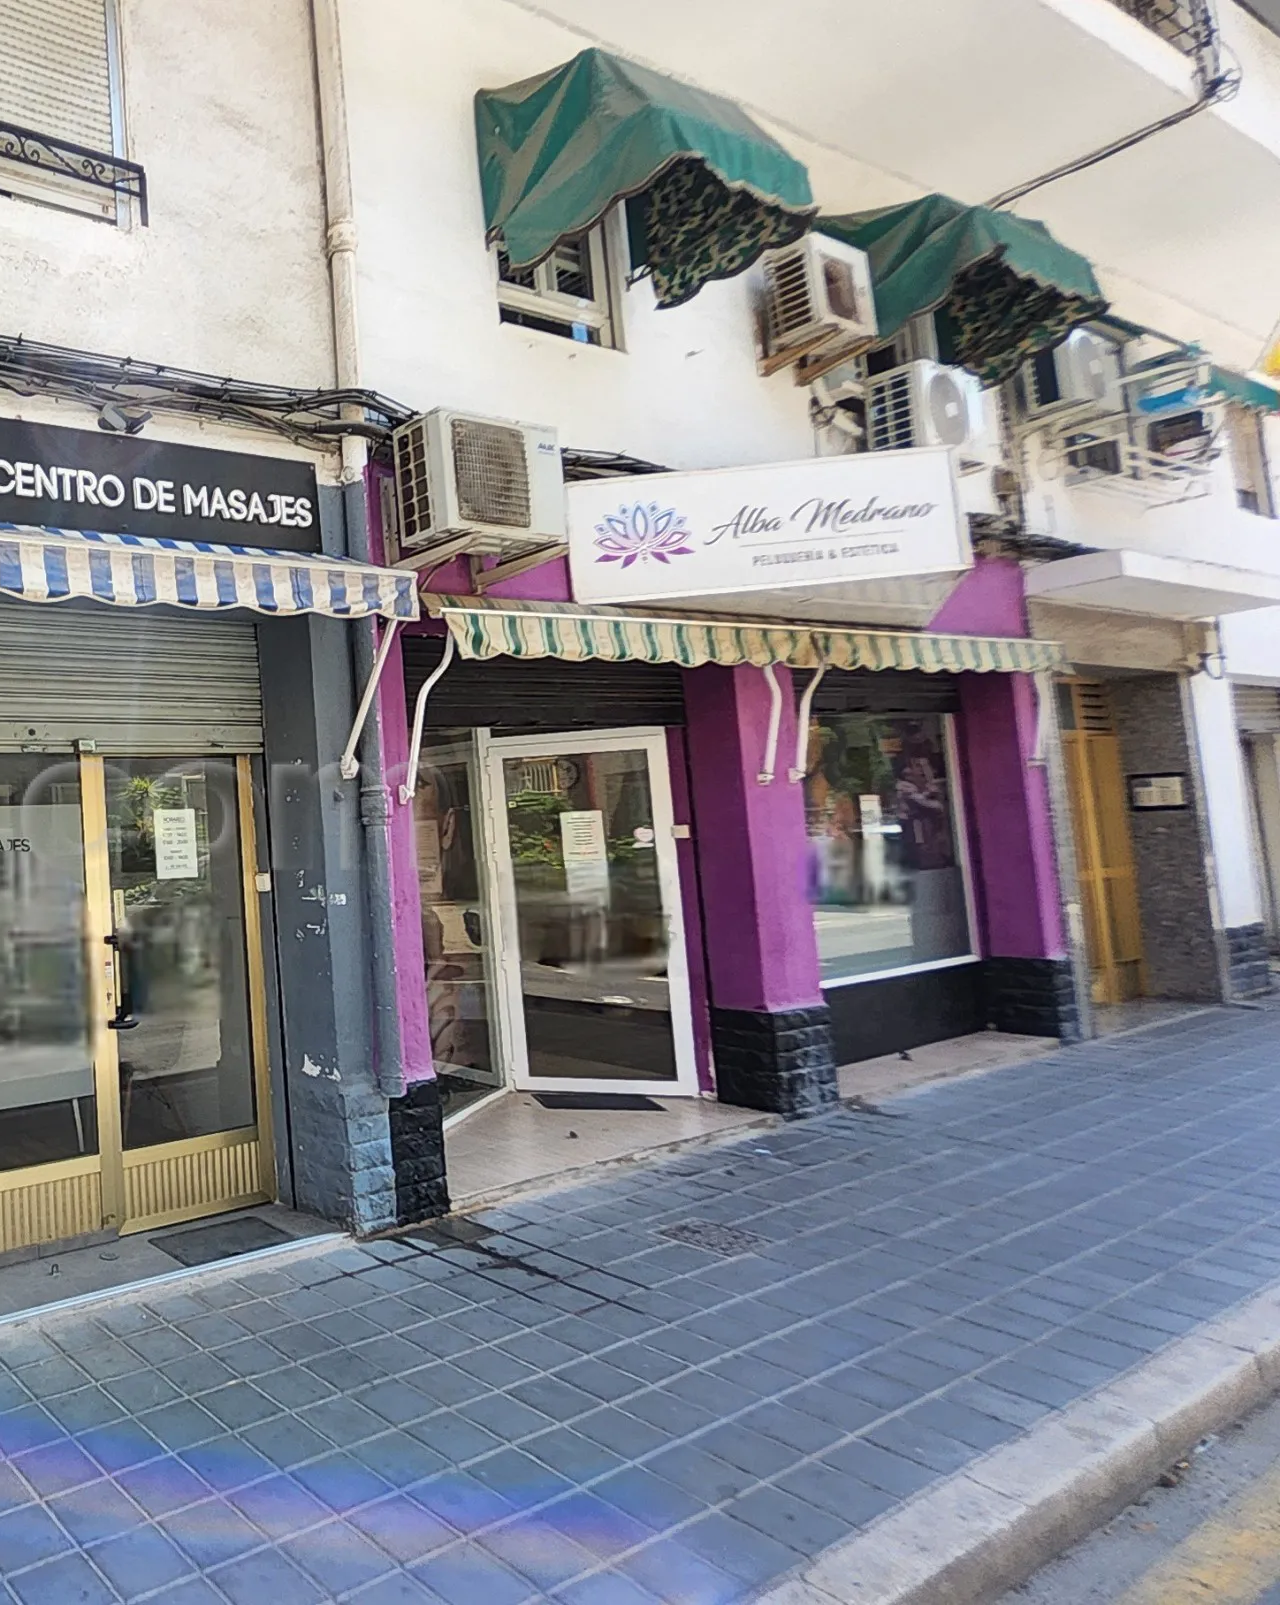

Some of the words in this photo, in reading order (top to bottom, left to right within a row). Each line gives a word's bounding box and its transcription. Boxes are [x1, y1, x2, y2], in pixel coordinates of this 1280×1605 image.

[132, 477, 177, 514] DE
[183, 484, 313, 528] MASAJES
[703, 504, 785, 546] Alba
[789, 495, 939, 534] Medrano
